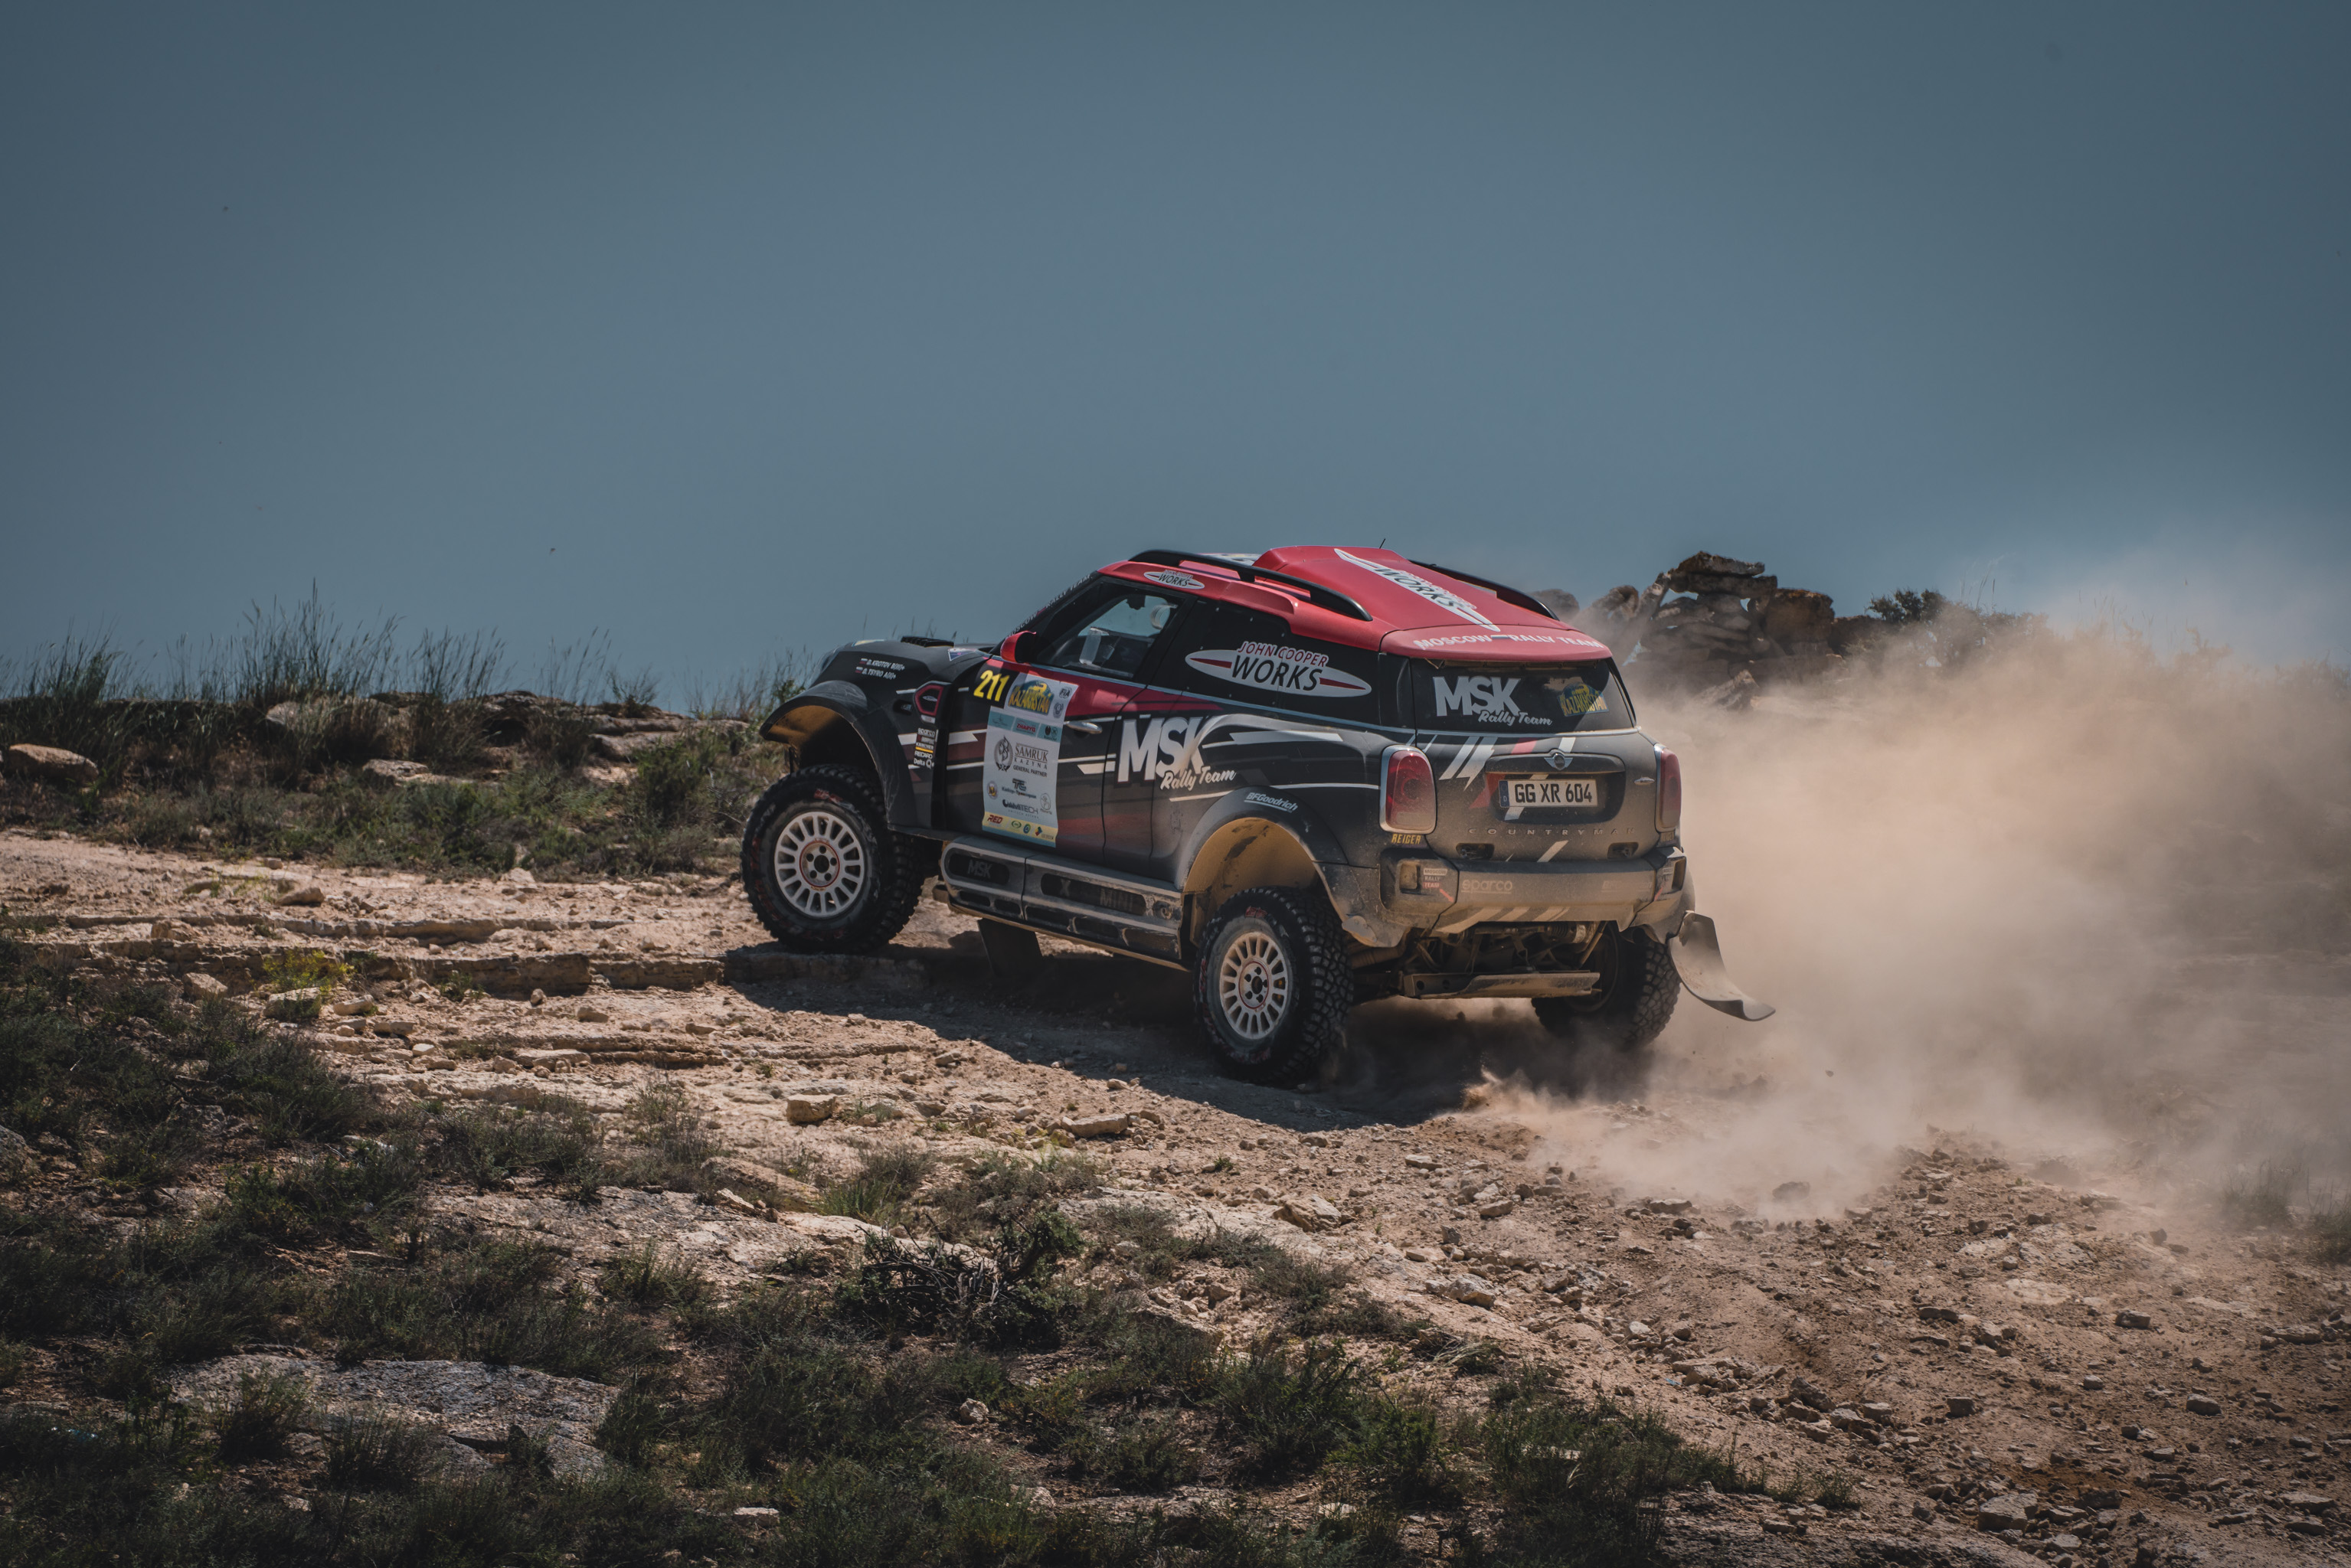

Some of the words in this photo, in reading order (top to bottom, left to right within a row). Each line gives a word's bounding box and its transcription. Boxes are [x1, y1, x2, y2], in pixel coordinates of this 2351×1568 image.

[1158, 573, 1189, 586] WORKS
[1375, 567, 1466, 608] WORKS
[1413, 635, 1493, 651] MOSCOW
[1506, 634, 1556, 645] RALLY
[1556, 636, 1604, 649] TEAM
[1238, 642, 1277, 657] JOHN
[1277, 646, 1329, 668] COOPER
[1231, 655, 1323, 691] WORKS
[973, 670, 1010, 702] 211
[1059, 688, 1071, 697] FIA
[1432, 675, 1521, 717] MSK
[1007, 688, 1051, 714] KAZAKHSTAN
[1561, 692, 1607, 716] KAZAKHSTAN
[1478, 710, 1516, 727] Rally
[1517, 712, 1552, 726] Team
[1015, 744, 1048, 762] SAMRUK
[1117, 717, 1205, 782] MSK
[914, 758, 925, 766] Delta
[1013, 765, 1030, 773] GENERAL
[1030, 769, 1048, 777] PARTNER
[1014, 757, 1048, 769] KAZYNA
[1160, 769, 1196, 791] Rally
[1198, 766, 1237, 785] Team
[1246, 792, 1298, 812] BFGoodrich
[1515, 783, 1535, 803] GG
[1540, 783, 1561, 803] XR
[1565, 783, 1592, 802] 604
[987, 815, 1003, 825] RED
[1467, 828, 1635, 836] COUNTRYMAN
[966, 858, 993, 879] MSK
[1461, 879, 1513, 893] sparco
